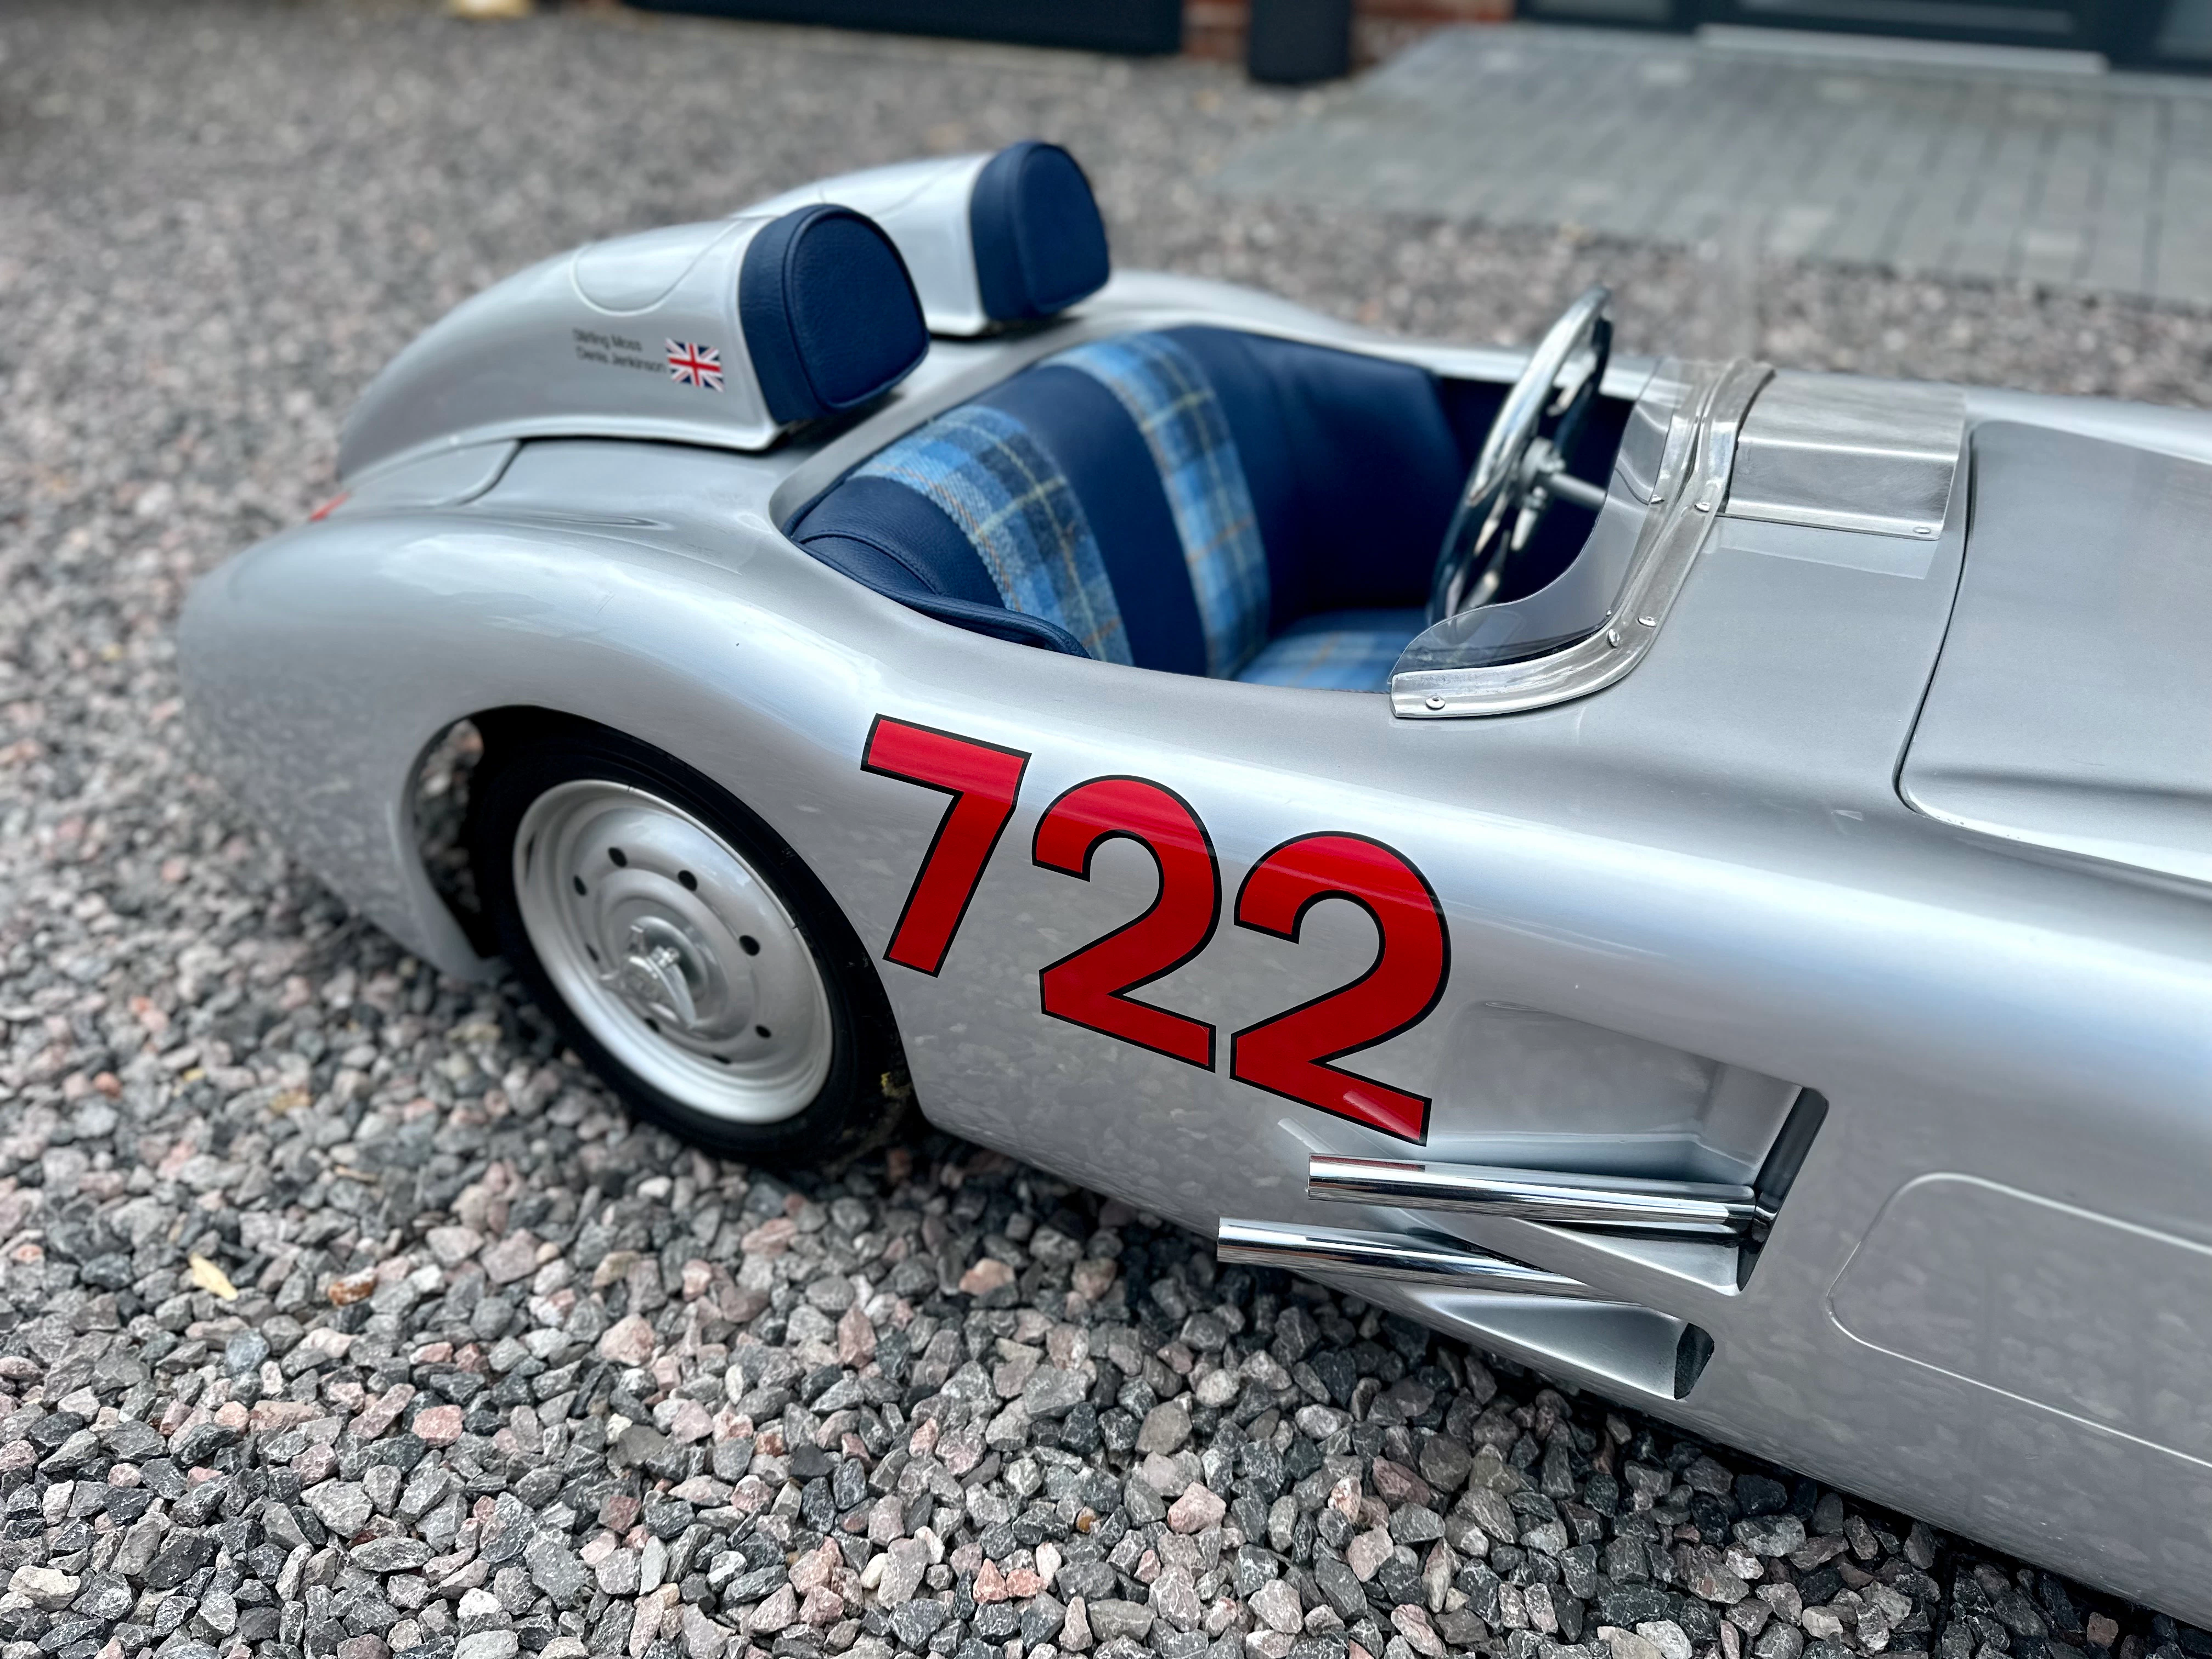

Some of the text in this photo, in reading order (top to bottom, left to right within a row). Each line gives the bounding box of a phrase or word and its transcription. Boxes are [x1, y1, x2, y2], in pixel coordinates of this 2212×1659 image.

[611, 334, 642, 352] Moss
[575, 346, 666, 373] Denis Jenkinson
[860, 713, 1451, 1147] 722
